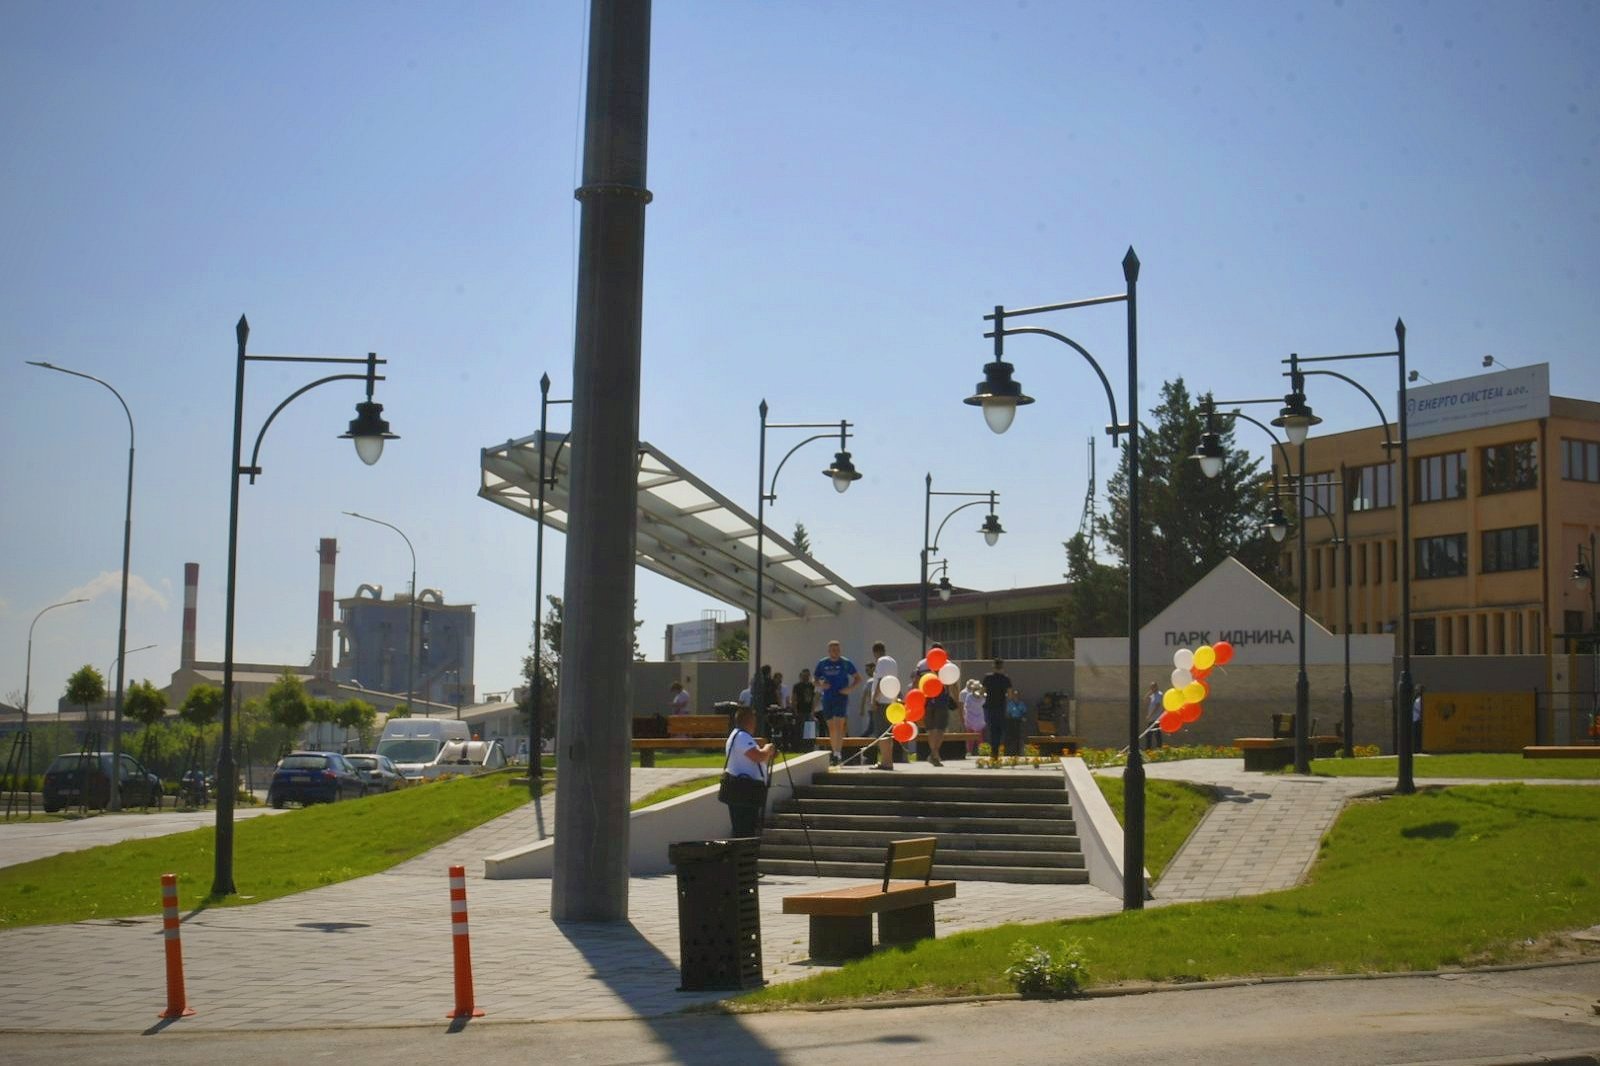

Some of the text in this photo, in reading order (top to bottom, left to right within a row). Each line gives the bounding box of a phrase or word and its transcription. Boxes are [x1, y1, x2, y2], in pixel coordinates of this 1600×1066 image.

[1418, 394, 1458, 412] ЕНЕРГО
[1460, 386, 1505, 404] СИСТЕМ
[1164, 629, 1295, 647] ПАРК ИДНИНА
